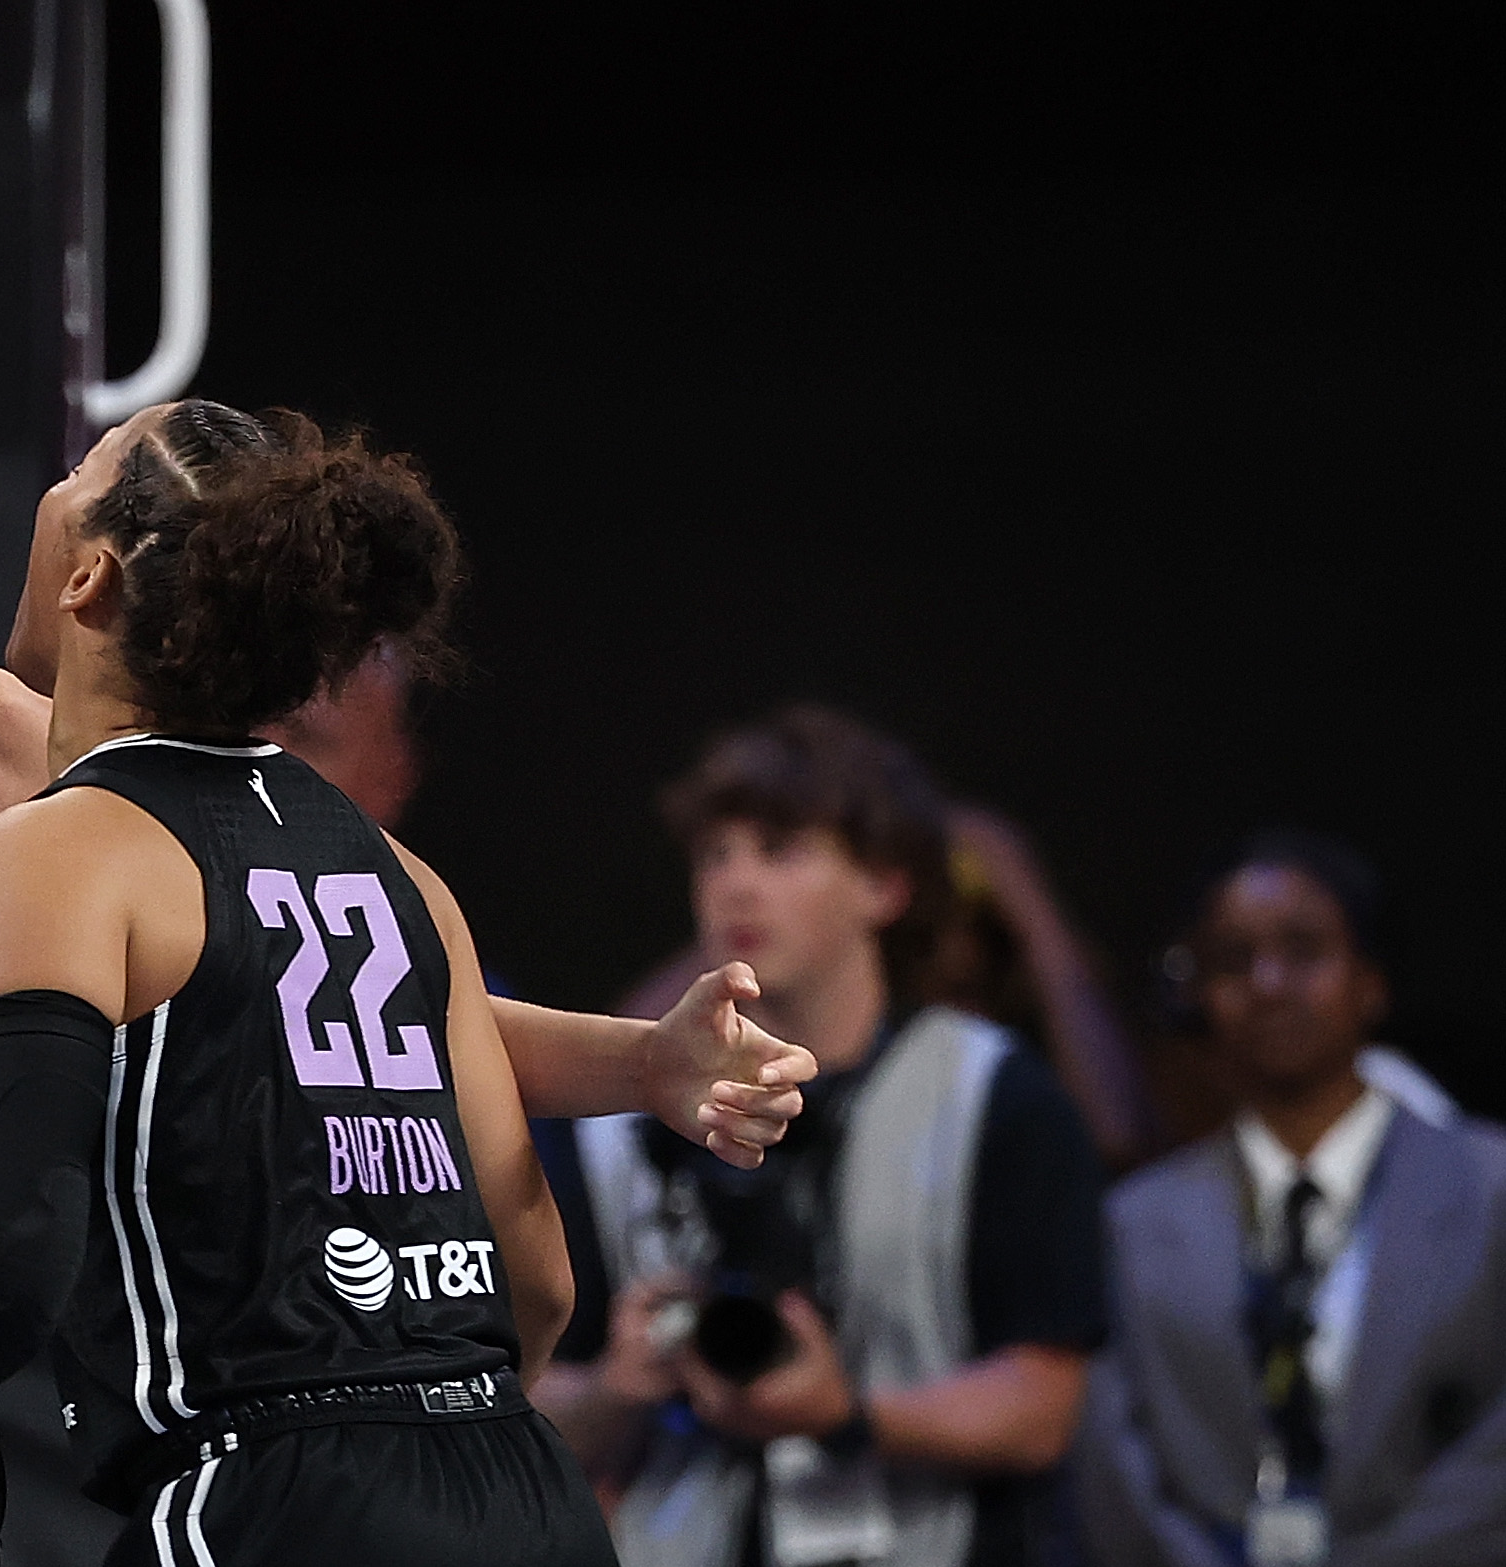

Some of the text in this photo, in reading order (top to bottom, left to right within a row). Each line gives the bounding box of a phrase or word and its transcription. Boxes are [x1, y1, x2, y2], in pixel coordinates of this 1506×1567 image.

[246, 868, 444, 1091] 22
[323, 1115, 463, 1195] BURTON
[398, 1240, 495, 1300] T&T
